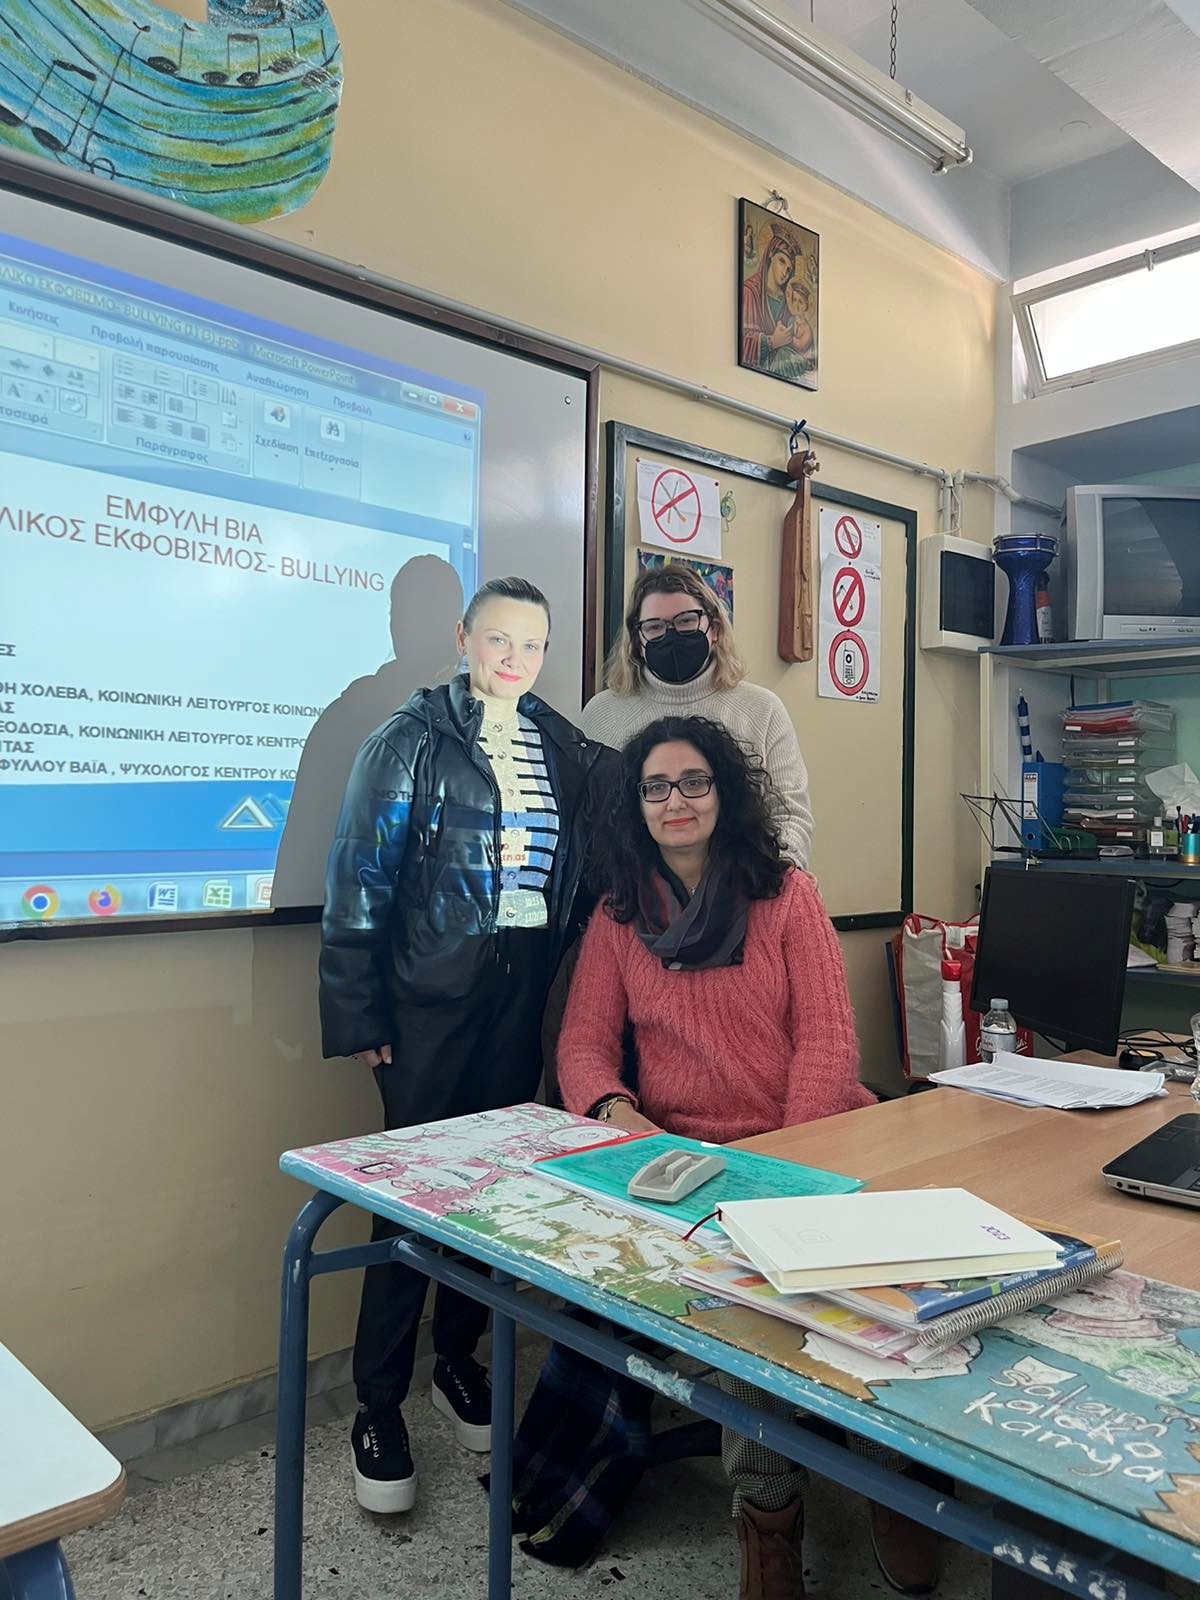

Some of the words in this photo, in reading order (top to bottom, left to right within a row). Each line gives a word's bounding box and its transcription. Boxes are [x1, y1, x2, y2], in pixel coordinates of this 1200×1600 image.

[0, 266, 34, 287] ΛΙΚΟ
[106, 494, 218, 537] ΕΜΦΥΛΗ
[225, 517, 263, 545] ΒΙΑ
[0, 506, 87, 543] ΛΙΚΟΣ
[95, 523, 276, 573] ΕΚΦΟΒΙΣΜΟΣ-
[281, 556, 385, 592] BULLYING
[21, 682, 93, 703] ΧΟΛΕΒΑ,
[98, 689, 182, 708] ΚΟΙΝΩΝΙΚΗ
[187, 696, 270, 714] ΛΕΙΤΟΥΡΓΟΣ
[273, 703, 326, 717] ΚΟΙΝΩΝ
[79, 725, 165, 742] ΚΟΙΝΩΝΙΚΗ
[168, 730, 254, 747] ΛΕΙΤΟΥΡΓΟΣ
[120, 763, 210, 778] ΨΥΧΟΛΟΓΟΣ
[214, 766, 278, 780] ΚΕΝΤΡΟΥ
